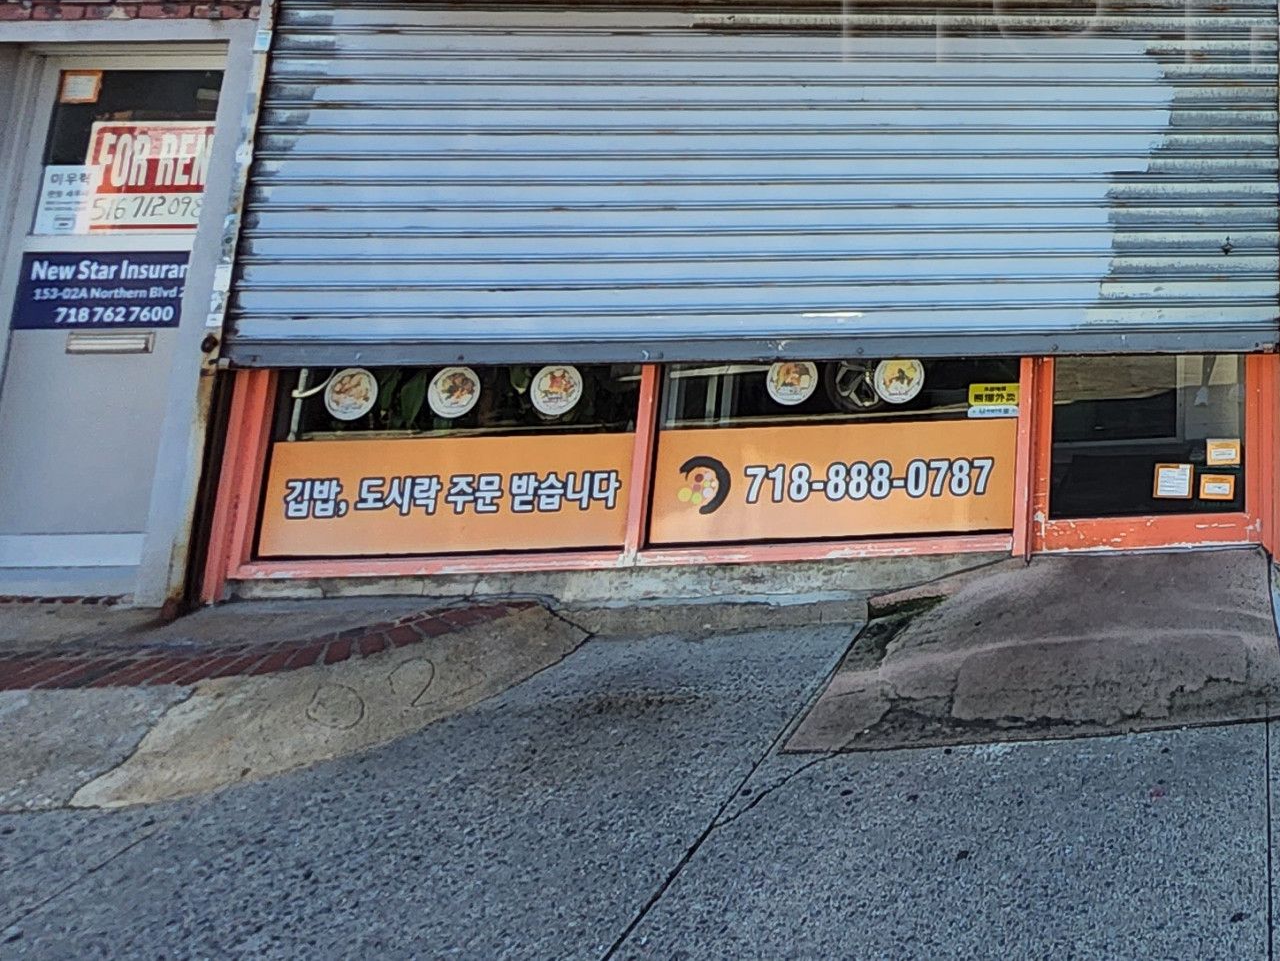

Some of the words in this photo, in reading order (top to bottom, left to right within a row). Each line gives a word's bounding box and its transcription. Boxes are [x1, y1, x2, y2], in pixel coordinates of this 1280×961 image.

[97, 132, 151, 187] FOR
[131, 195, 167, 219] 712
[31, 260, 76, 281] New
[77, 259, 118, 280] Star
[90, 287, 148, 299] Northern
[149, 286, 177, 298] Blvd
[55, 307, 90, 323] 718
[92, 307, 127, 323] 762
[129, 306, 174, 322] 7600
[744, 455, 996, 504] 718-888-0787
[285, 478, 348, 518] 김밥,
[356, 475, 443, 515] 도시락
[446, 472, 501, 514] 주문
[510, 470, 621, 513] 받습니다
